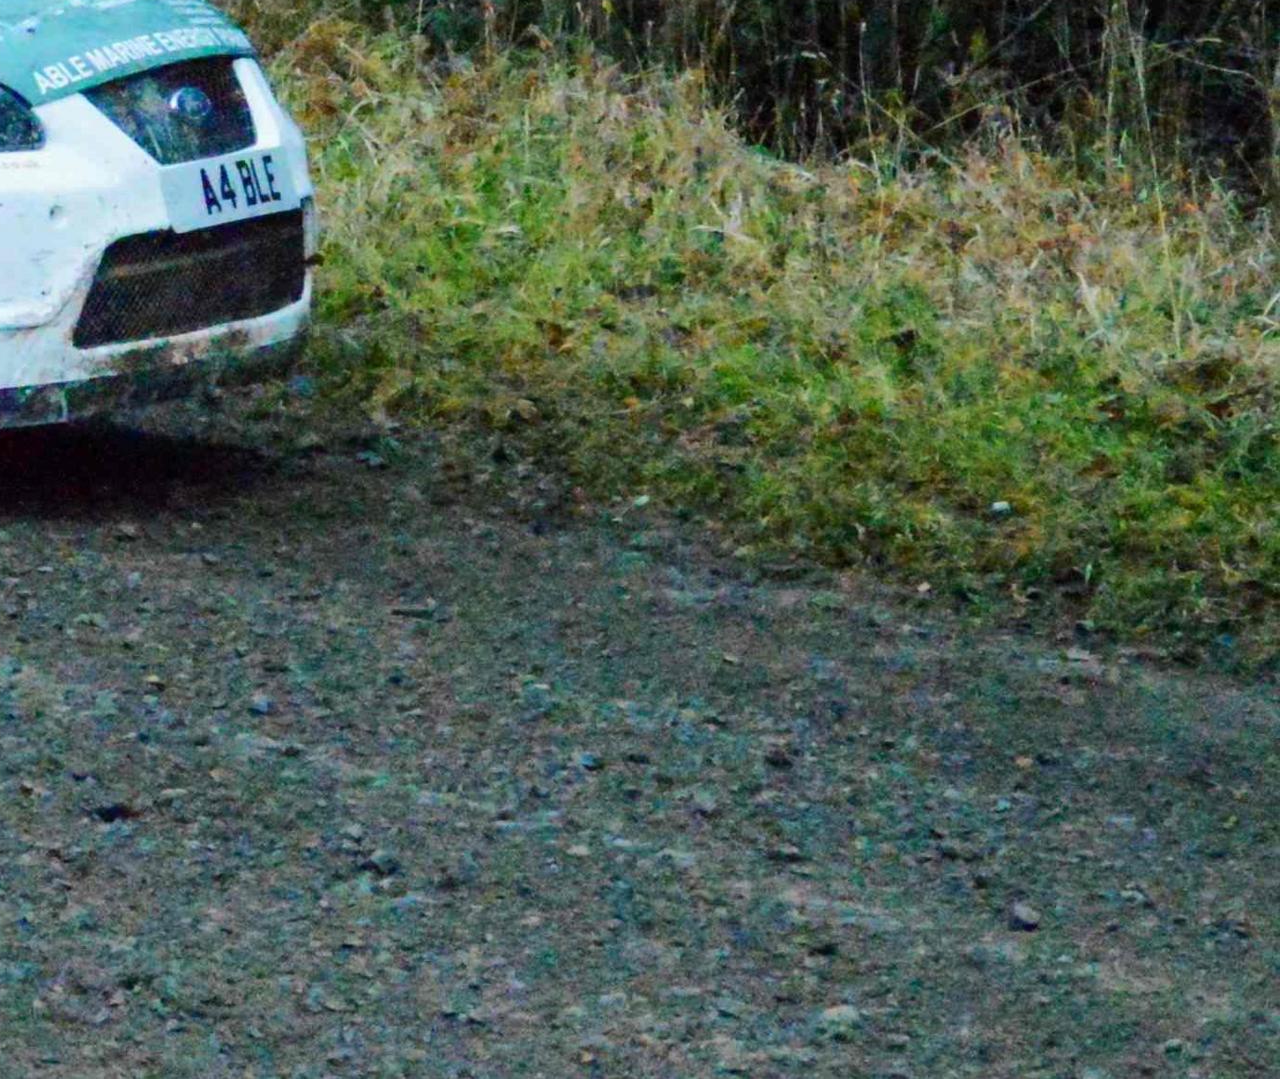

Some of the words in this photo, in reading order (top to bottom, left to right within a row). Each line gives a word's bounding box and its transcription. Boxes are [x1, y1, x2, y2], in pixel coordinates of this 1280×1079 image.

[32, 56, 94, 95] ABLE
[85, 35, 164, 72] MARINE
[199, 164, 238, 215] A4
[236, 155, 282, 206] BLE
